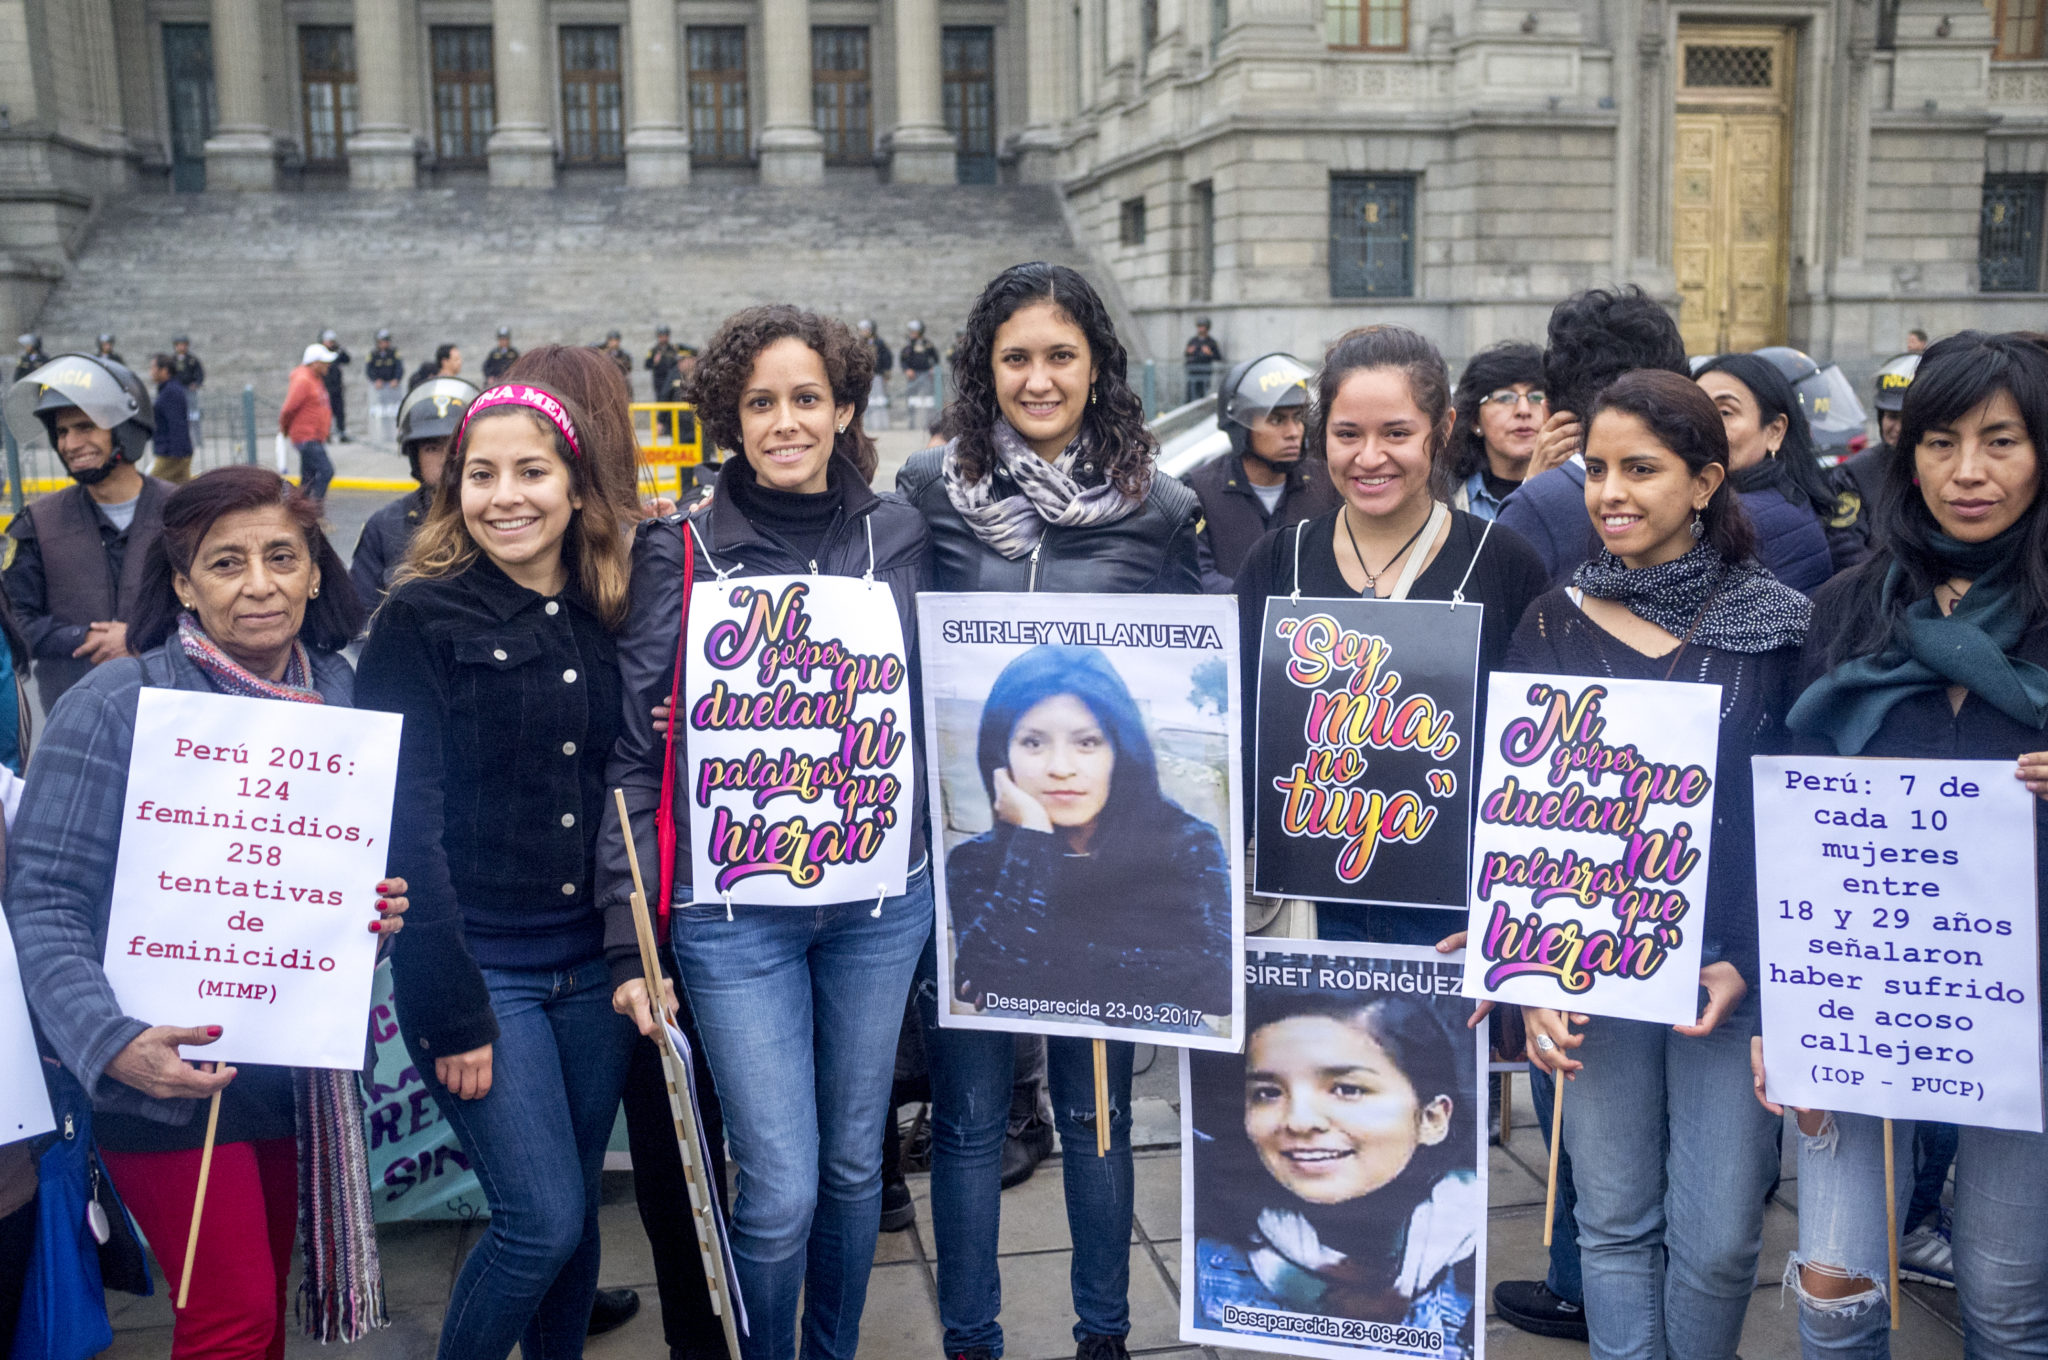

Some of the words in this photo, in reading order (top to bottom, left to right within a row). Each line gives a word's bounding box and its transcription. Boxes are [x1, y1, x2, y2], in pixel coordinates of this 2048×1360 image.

[466, 385, 515, 418] UNA
[943, 620, 1055, 645] SHIRLEY
[1054, 622, 1223, 649] VILLANUEVA
[757, 635, 848, 688] golpes
[831, 653, 906, 718] que
[691, 679, 848, 733] duelan,
[840, 708, 906, 770] ni
[1305, 671, 1460, 761] mía,
[174, 738, 249, 764] Perú
[268, 747, 355, 776] 2016:
[1305, 744, 1368, 786] no
[237, 776, 290, 801] 124
[697, 748, 850, 810] palabras
[834, 773, 901, 826] que
[1548, 738, 1644, 787] golpes
[1620, 763, 1712, 824] que
[1785, 770, 1872, 795] Perú:
[1900, 775, 1916, 796] 7
[1940, 777, 1980, 798] de
[136, 800, 374, 848] feminicidios,
[1481, 775, 1635, 840] duelan,
[1625, 822, 1701, 885] ni
[1814, 808, 1888, 829] cada
[1911, 809, 1948, 831] 10
[227, 842, 282, 867] 258
[1822, 841, 1959, 867] mujeres
[157, 870, 343, 906] tentativas
[1477, 847, 1633, 909] palabras
[1612, 888, 1690, 938] que
[1843, 876, 1940, 897] entre
[227, 910, 264, 932] de
[1779, 900, 1814, 920] 18
[1834, 908, 1853, 930] y
[1872, 907, 1910, 929] 29
[1932, 912, 2012, 936] años
[127, 935, 335, 972] feminicidio
[1808, 938, 1983, 966] señalaron
[197, 979, 278, 1004] (MIMP)
[1245, 965, 1312, 987] SIRET
[1319, 969, 1463, 996] RODRIGUEZ
[1769, 964, 1863, 990] haber
[1884, 976, 2025, 1004] sufrido
[986, 992, 1100, 1016] Desaparecida
[1105, 1002, 1202, 1027] 23-03-2017
[1818, 1000, 1854, 1020] de
[1875, 1010, 1974, 1031] acoso
[1800, 1033, 1974, 1065] callejero
[1811, 1064, 1865, 1086] (IOP
[1911, 1076, 1985, 1101] PUCP)
[1225, 1306, 1339, 1336] Desaparecida
[1342, 1322, 1442, 1350] 23-08-2016
